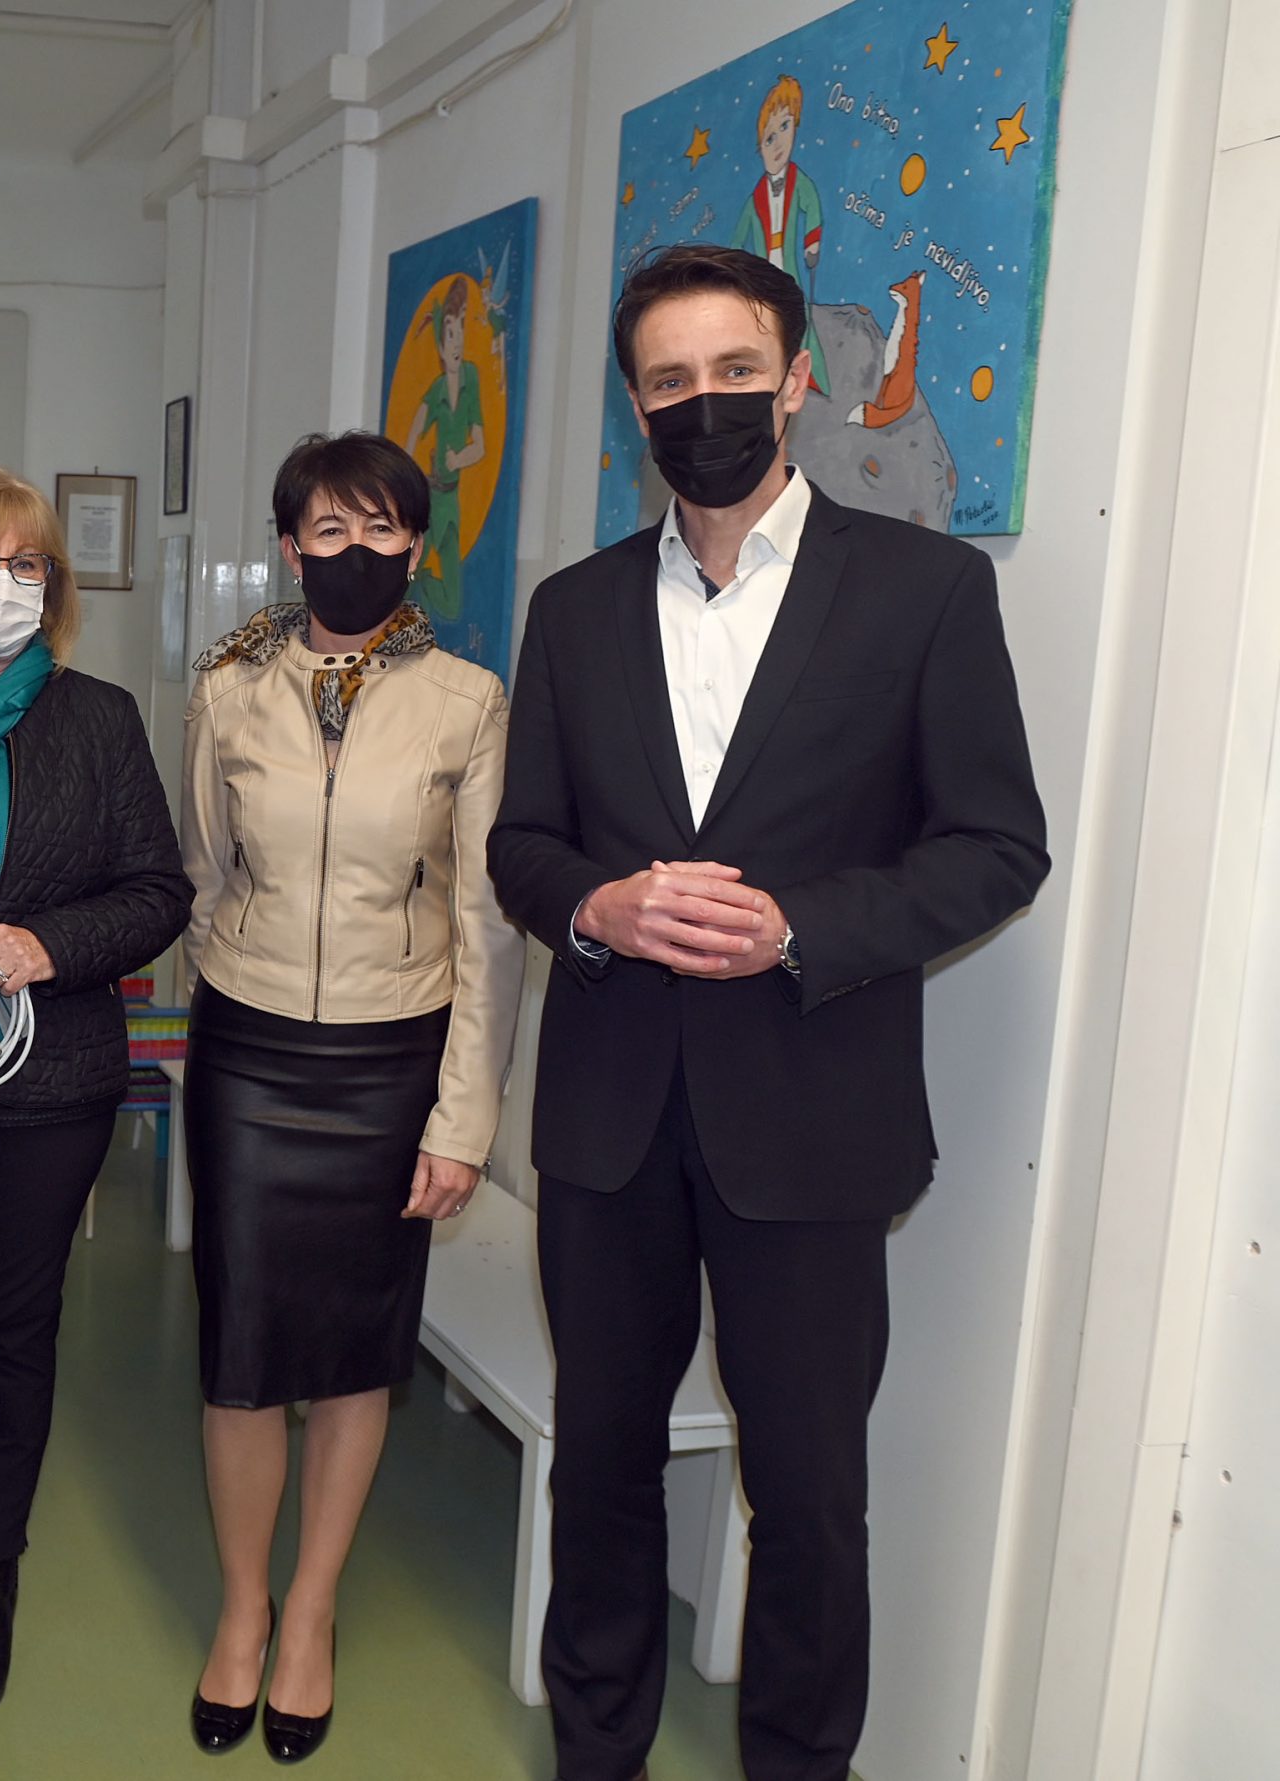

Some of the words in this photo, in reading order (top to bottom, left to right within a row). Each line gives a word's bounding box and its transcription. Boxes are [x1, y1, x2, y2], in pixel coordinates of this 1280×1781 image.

[828, 82, 855, 113] Ono
[844, 192, 887, 229] očima
[893, 220, 915, 250] je
[924, 240, 990, 313] nevidljivo.
